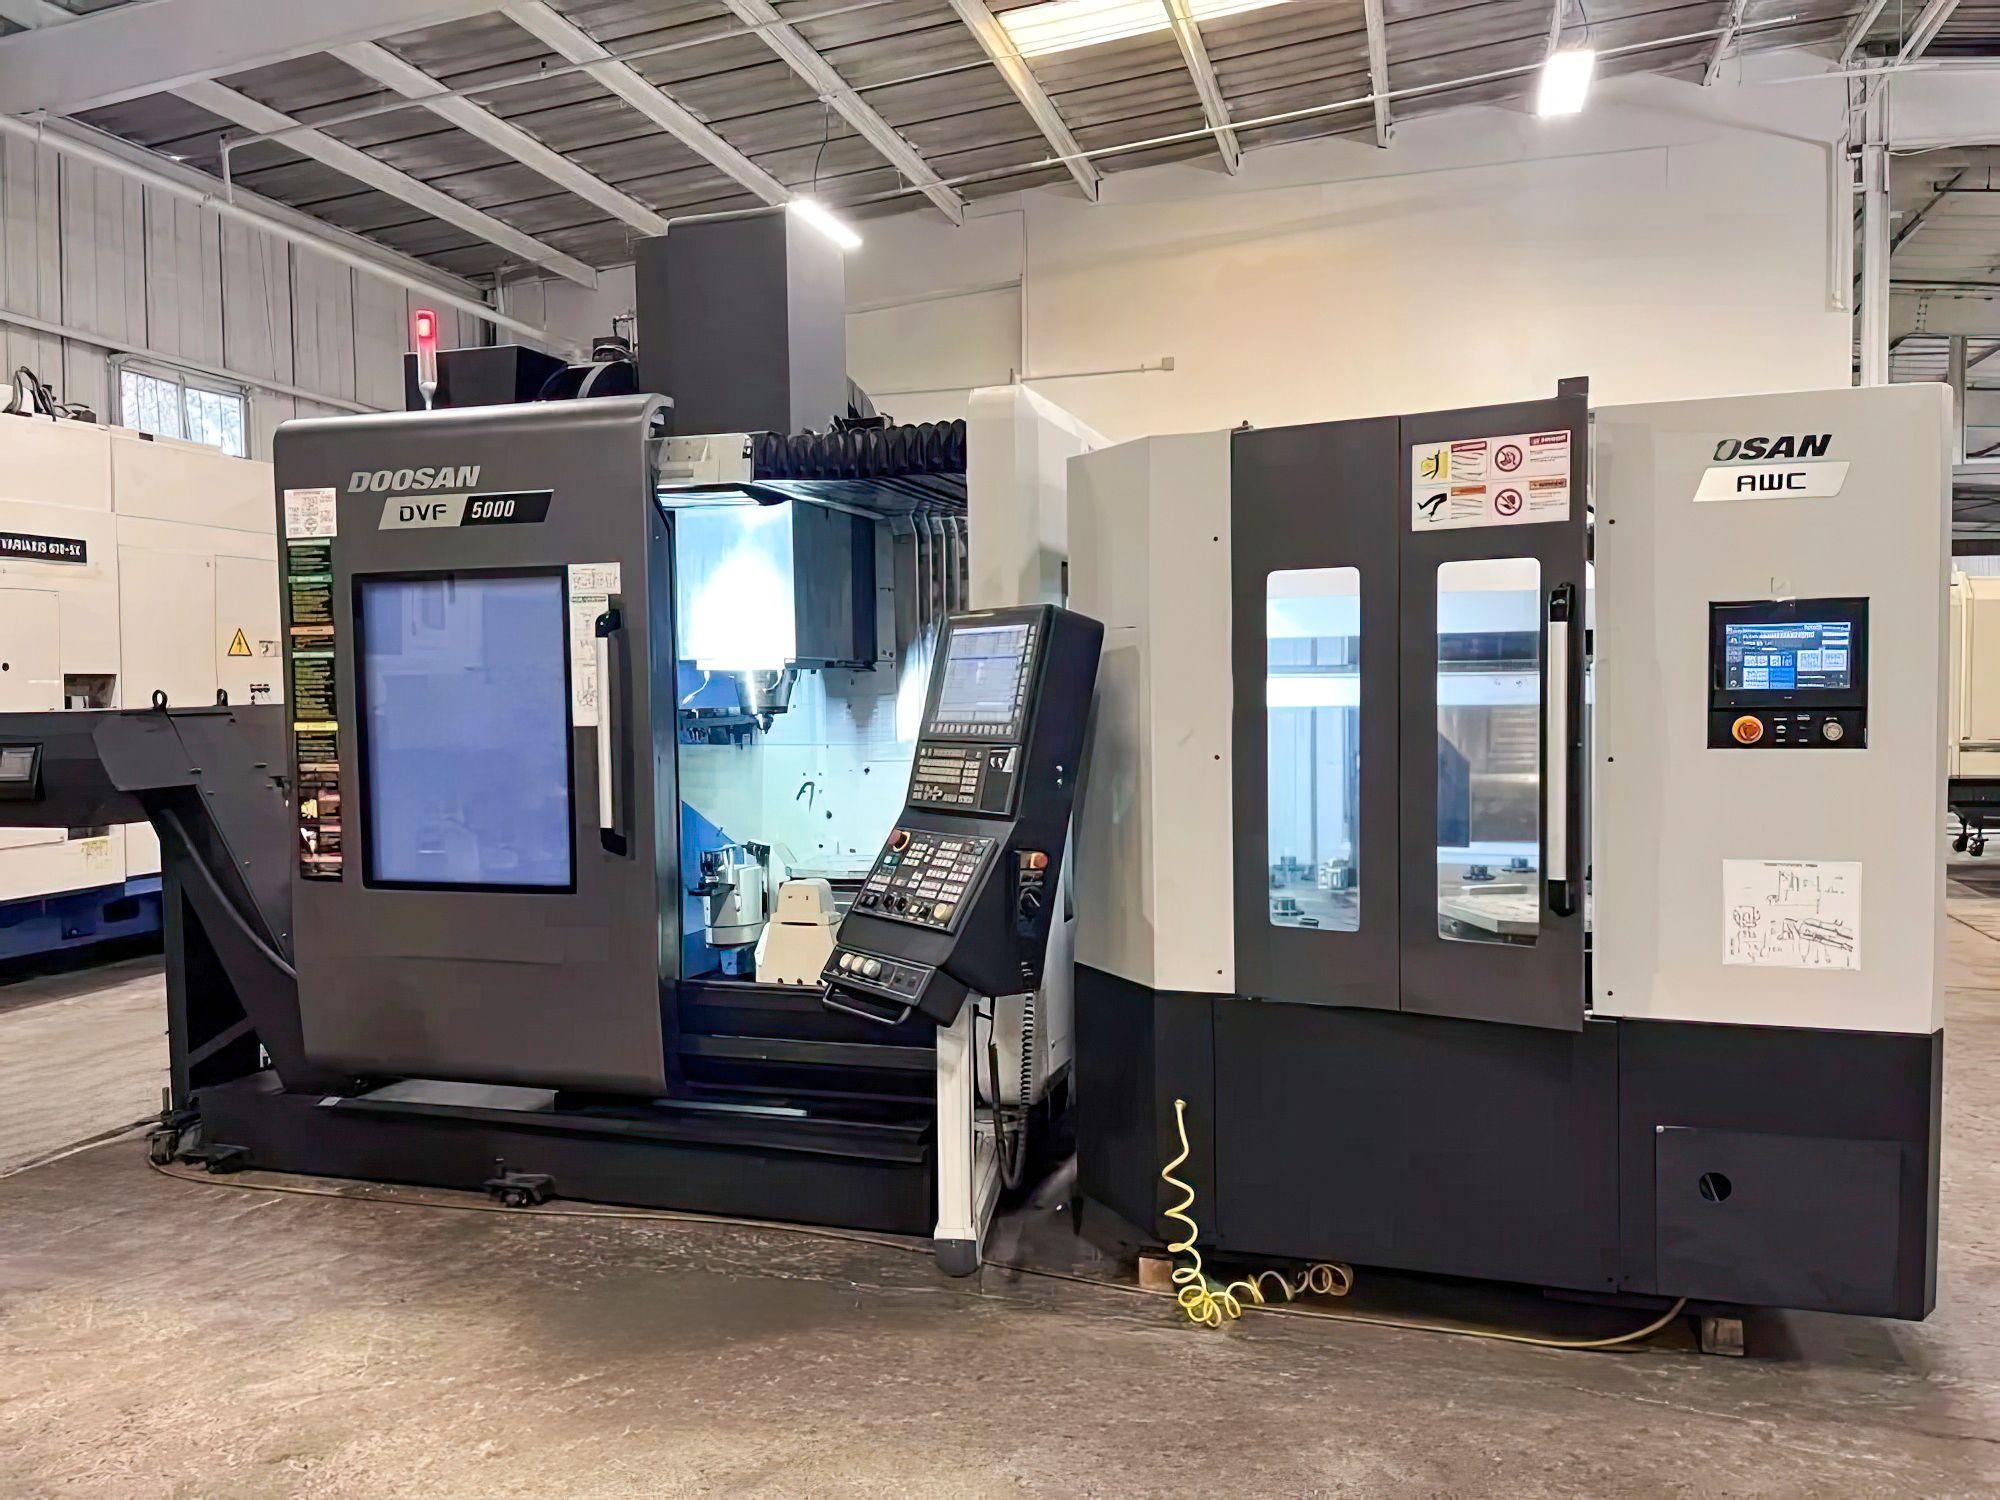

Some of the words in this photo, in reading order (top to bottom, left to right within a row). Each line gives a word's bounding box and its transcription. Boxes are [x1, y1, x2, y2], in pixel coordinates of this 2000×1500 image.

[1712, 433, 1833, 462] OSAN
[347, 465, 481, 493] DOOSAN
[1736, 472, 1807, 492] AWC
[399, 503, 448, 522] DVF
[471, 500, 515, 519] 5000
